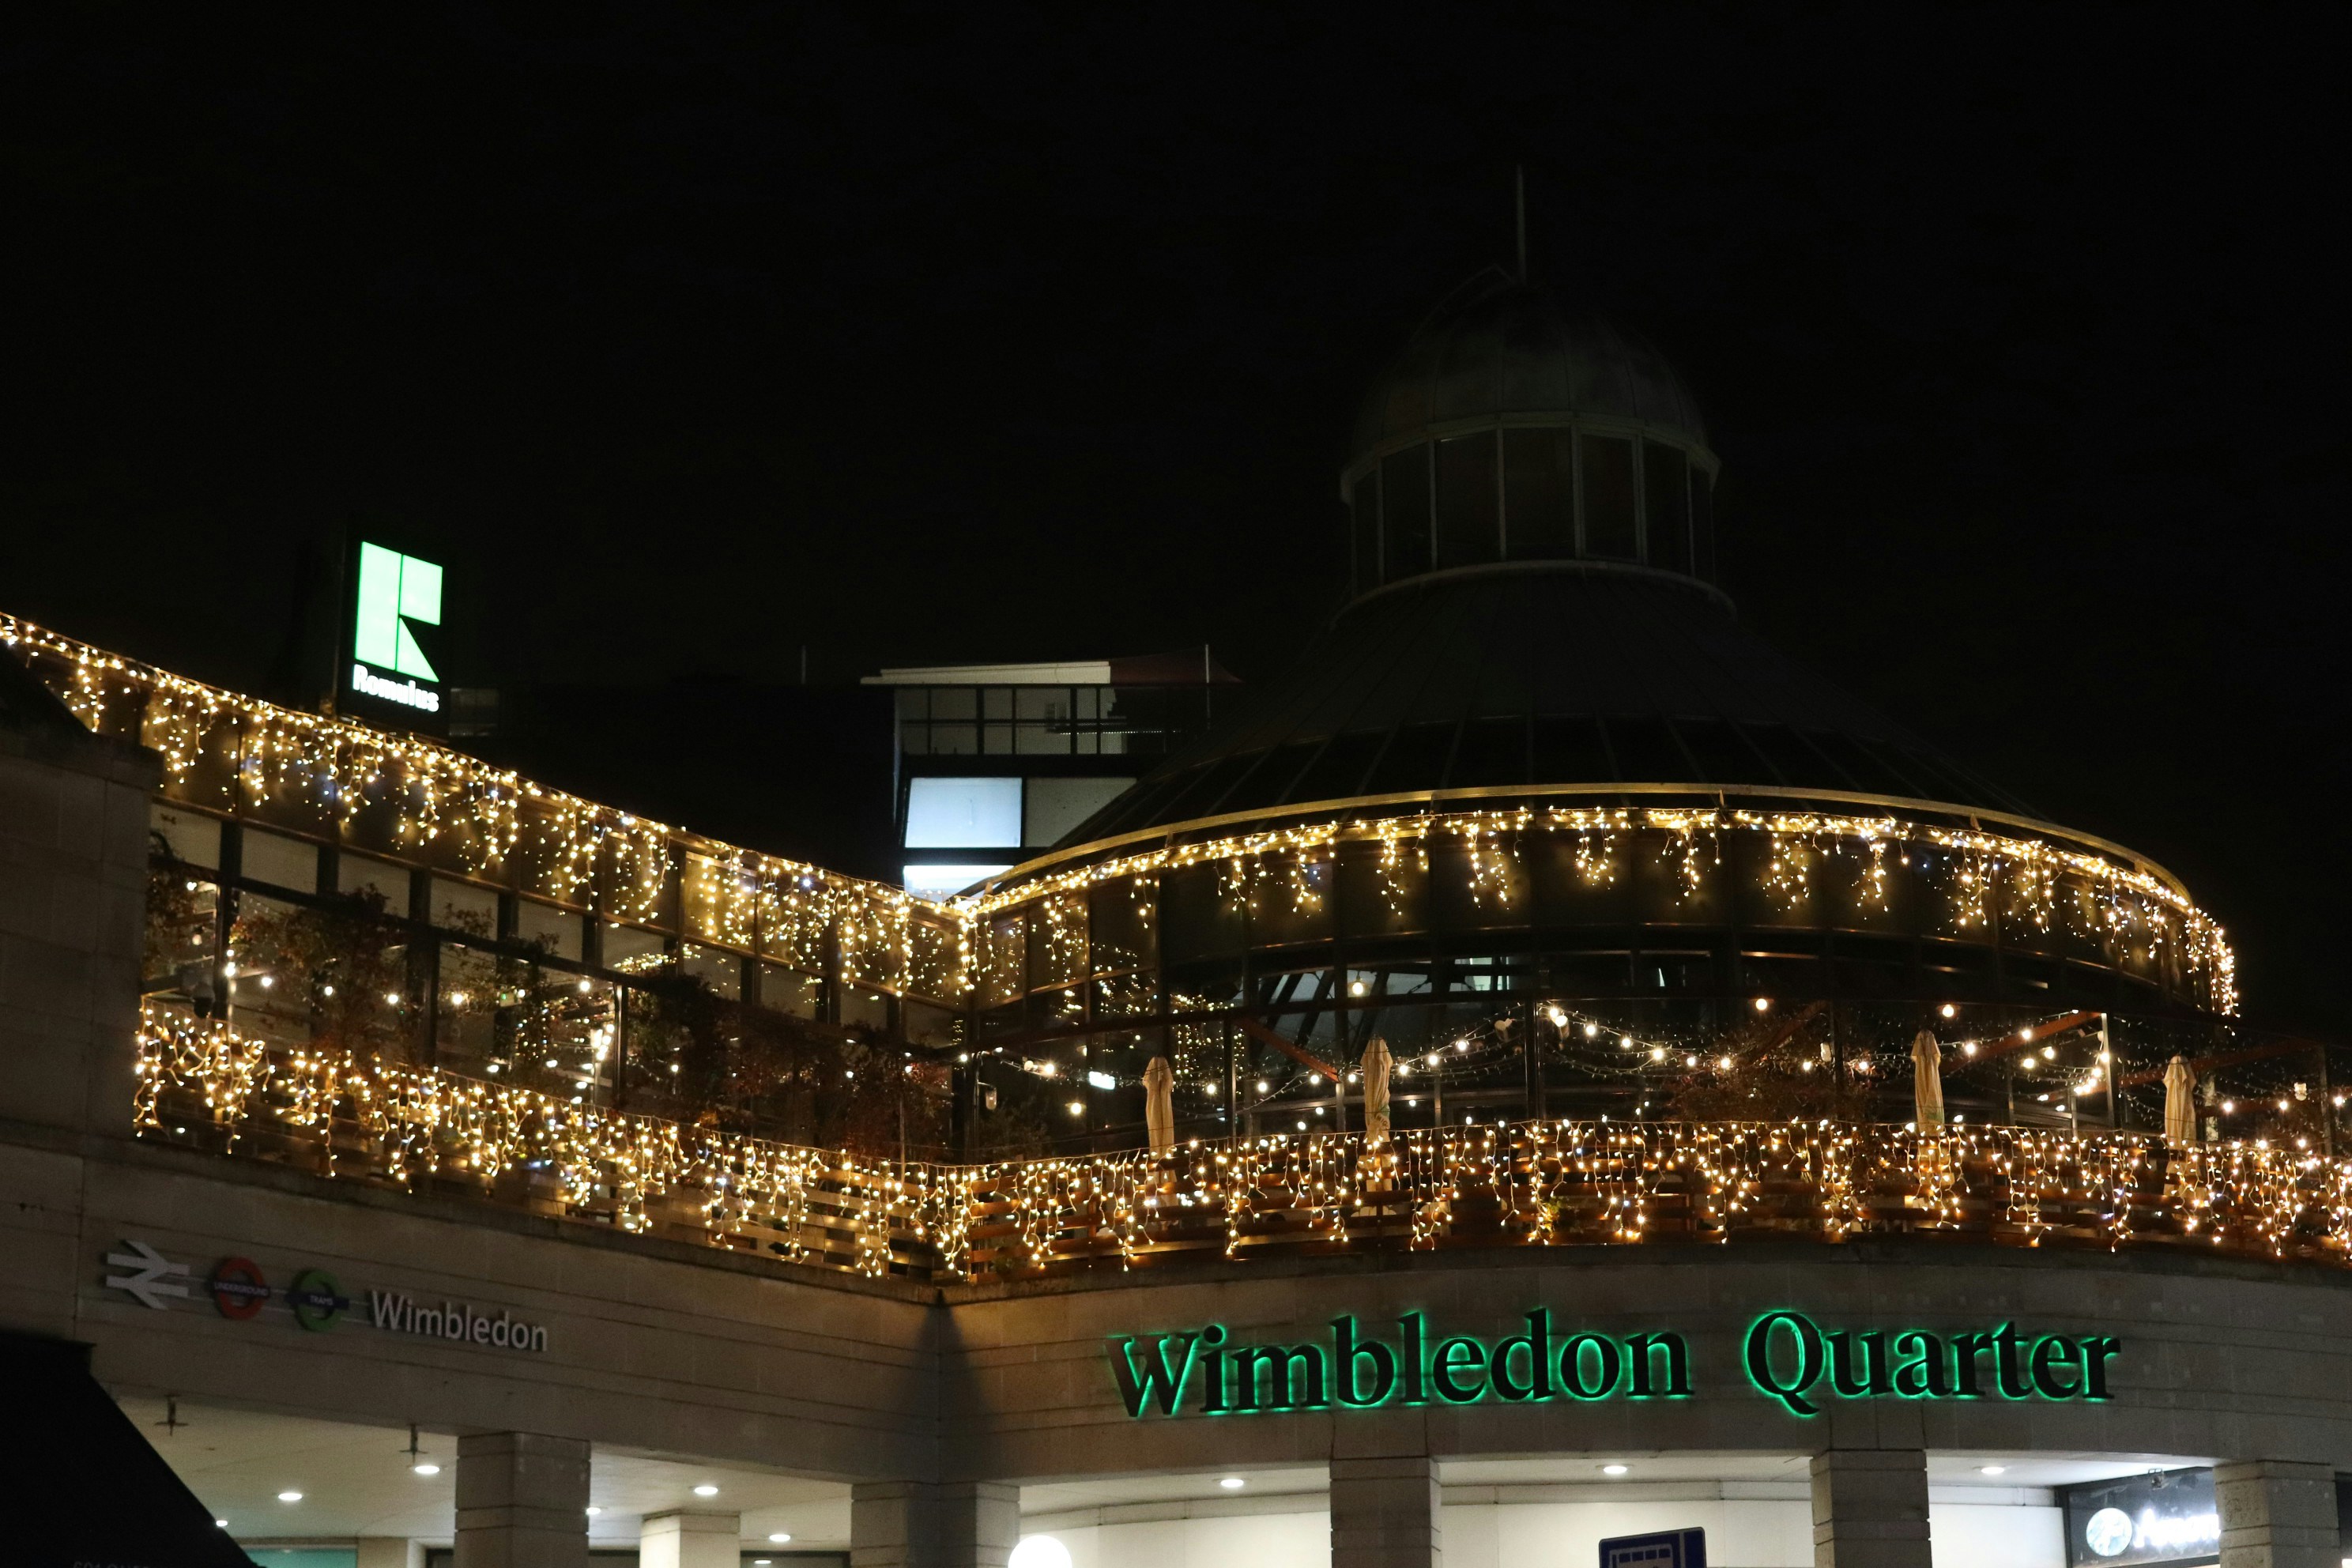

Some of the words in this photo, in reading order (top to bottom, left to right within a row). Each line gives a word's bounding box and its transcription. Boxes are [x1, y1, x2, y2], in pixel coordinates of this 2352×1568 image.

[214, 1280, 269, 1297] UNDERGROUND
[309, 1294, 334, 1306] TRAMS
[370, 1290, 548, 1351] Wimbledon
[1106, 1308, 1694, 1418] Wimbledon
[1744, 1310, 2121, 1416] Quarter
